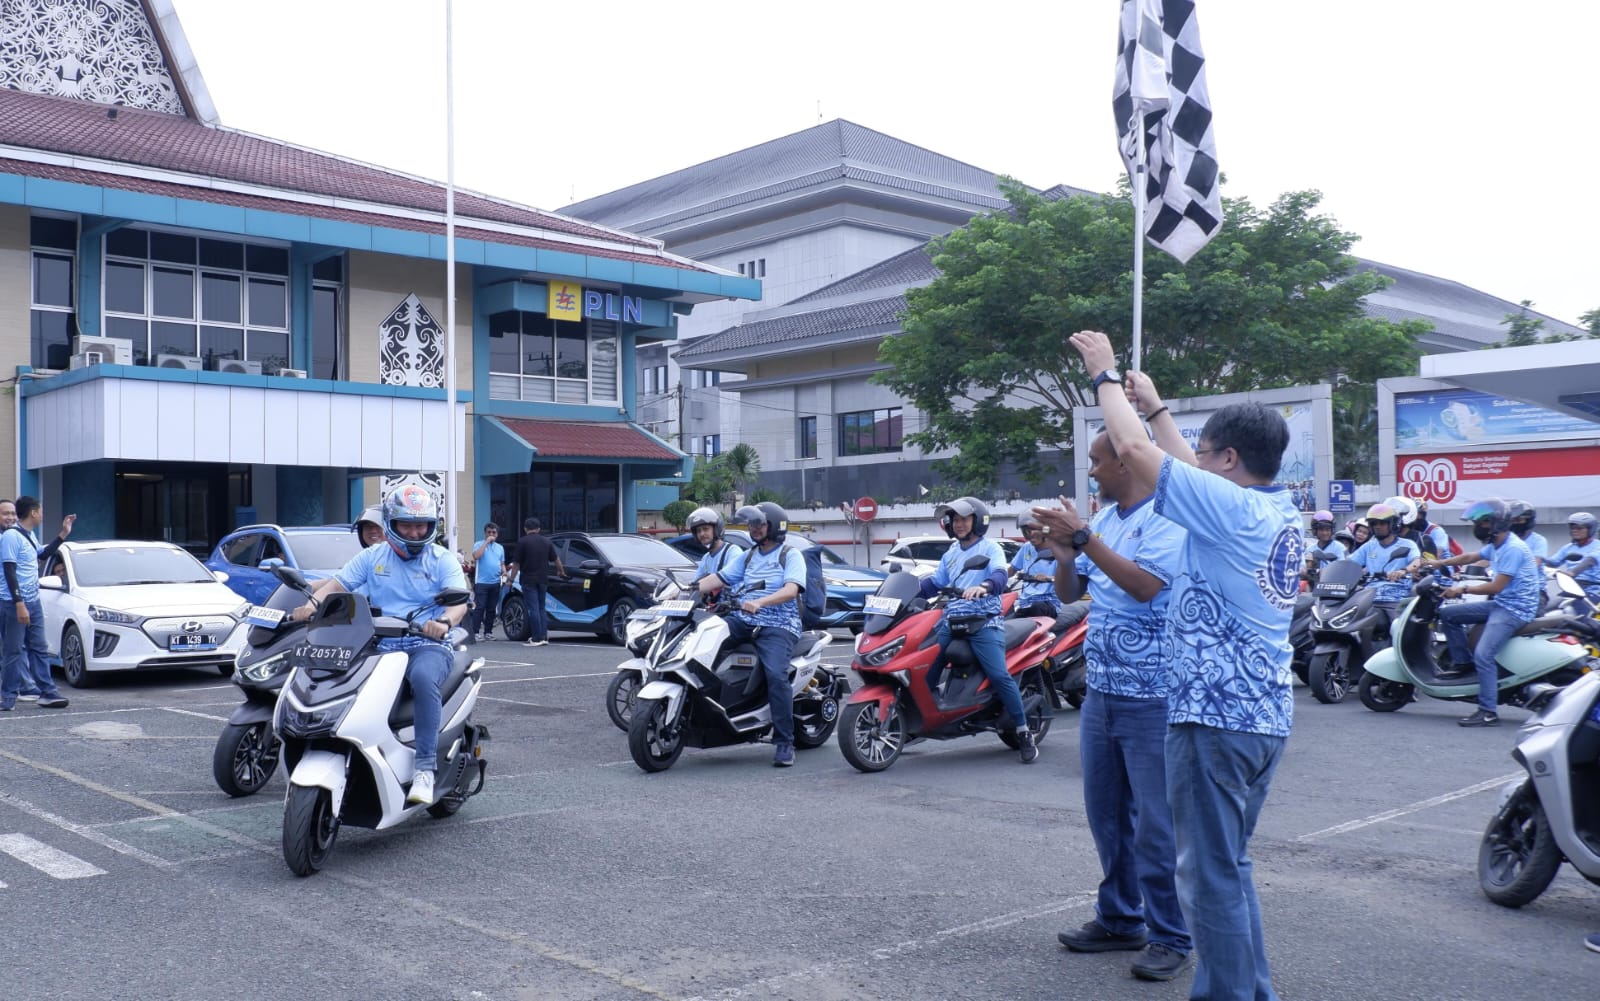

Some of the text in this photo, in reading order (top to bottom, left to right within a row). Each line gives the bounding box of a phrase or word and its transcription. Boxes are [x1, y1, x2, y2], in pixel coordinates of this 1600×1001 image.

[584, 290, 642, 323] PLN
[1402, 458, 1457, 504] 80
[1331, 483, 1343, 497] P
[171, 635, 180, 645] KT
[187, 635, 202, 644] 1439
[295, 647, 308, 657] KT
[310, 648, 337, 658] 2057
